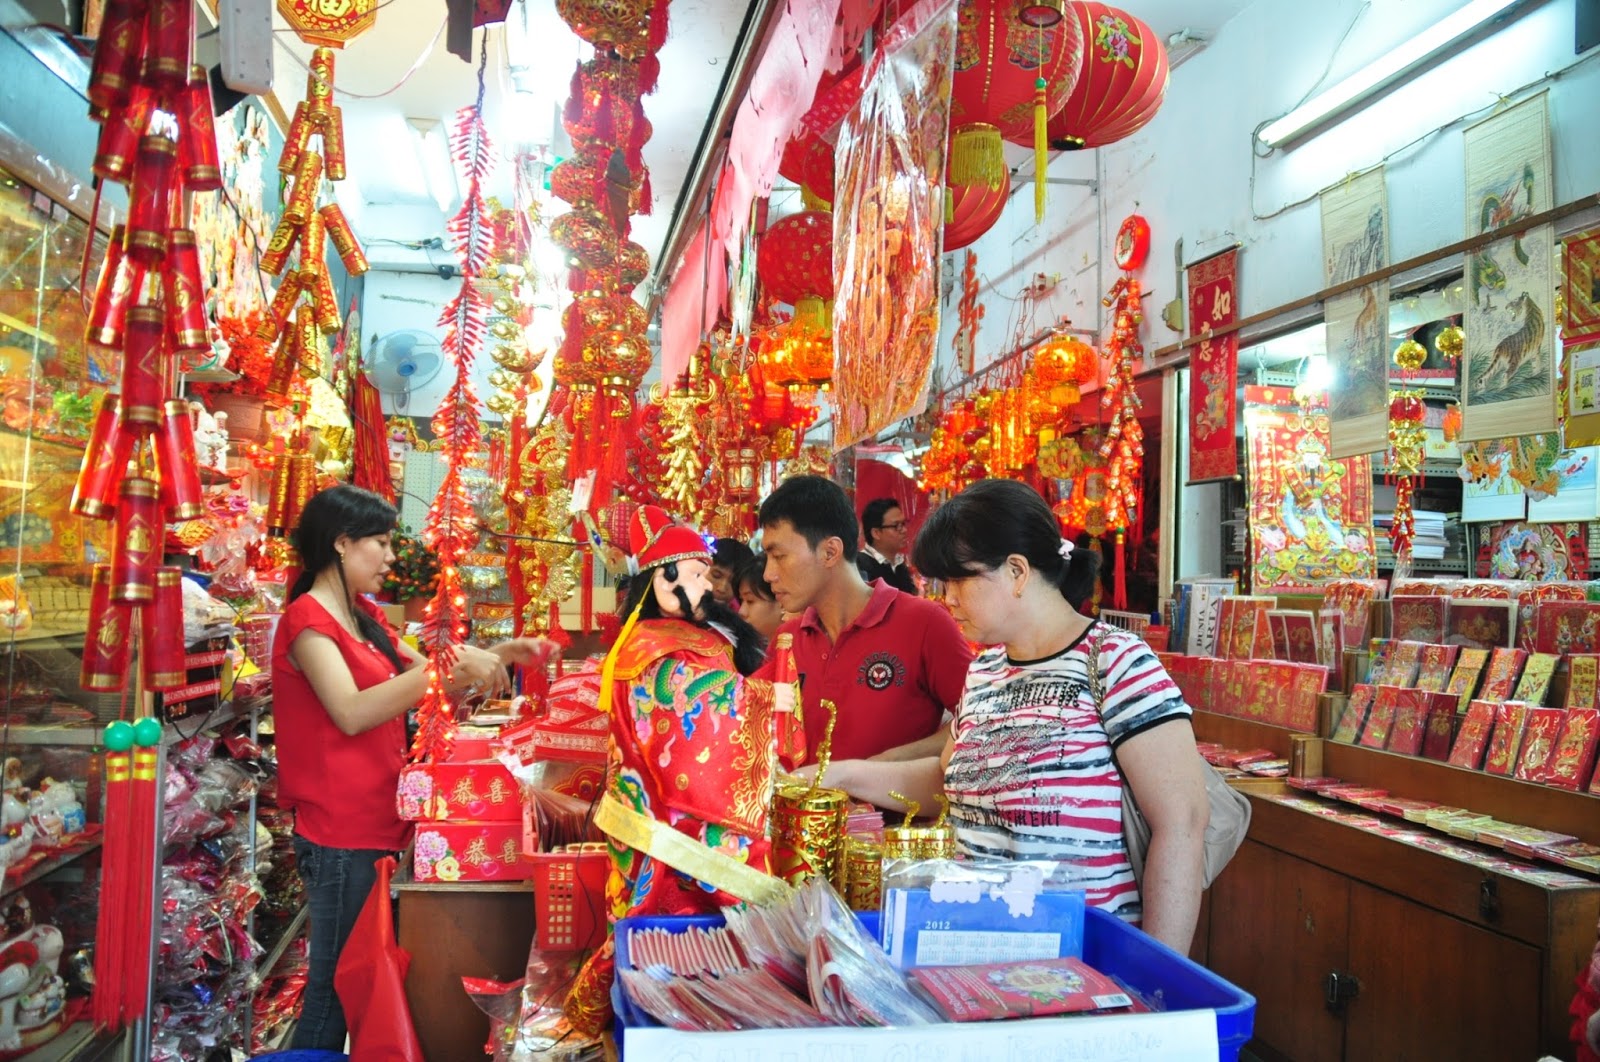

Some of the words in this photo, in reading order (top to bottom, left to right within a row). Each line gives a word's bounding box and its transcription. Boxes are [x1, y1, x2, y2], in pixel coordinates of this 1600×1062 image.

[1211, 285, 1231, 321] 如
[464, 839, 523, 866] 恭喜
[925, 921, 951, 930] 2012
